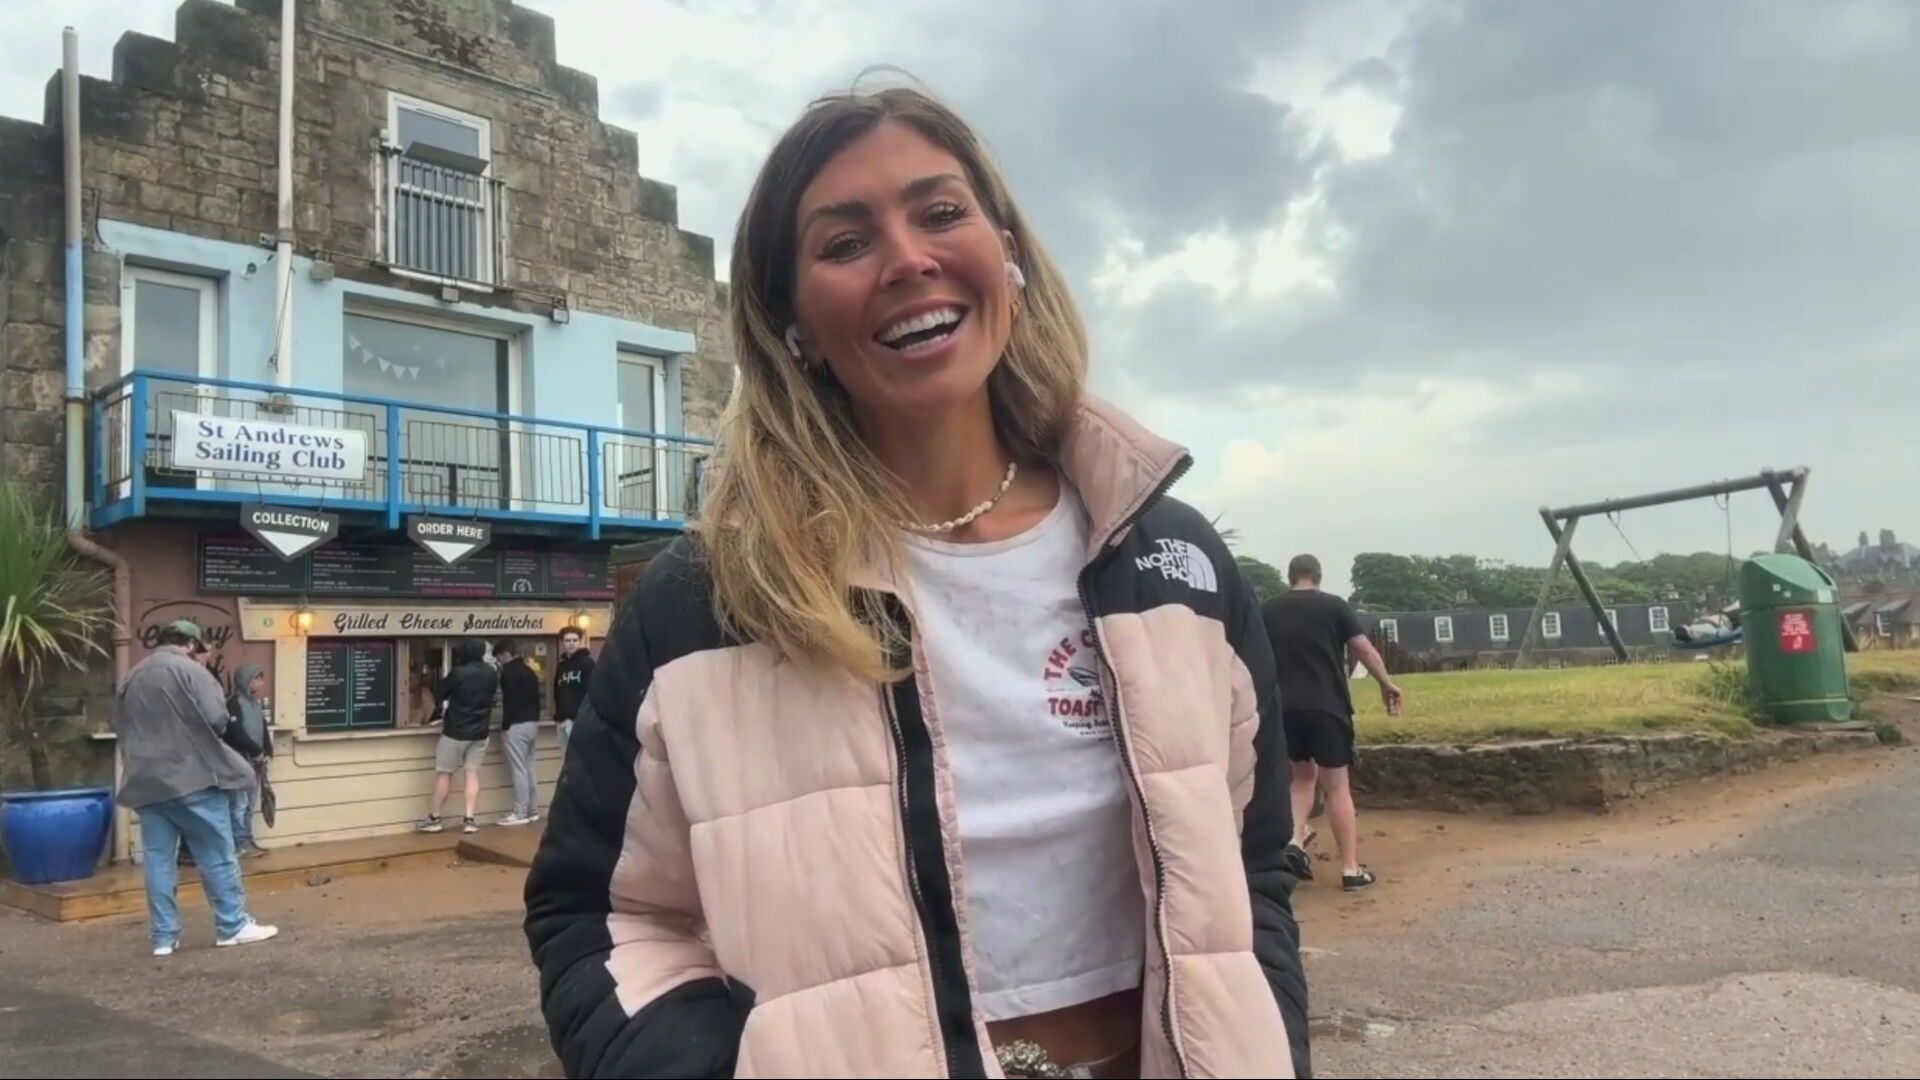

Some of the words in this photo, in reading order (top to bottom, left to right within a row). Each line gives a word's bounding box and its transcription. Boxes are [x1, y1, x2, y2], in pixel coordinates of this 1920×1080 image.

[198, 420, 224, 439] St
[234, 425, 344, 450] Andrews
[196, 441, 281, 470] Sailing
[292, 450, 346, 470] Club
[252, 511, 329, 533] COLLECTION
[417, 522, 453, 535] ORDER
[456, 525, 484, 539] HERE
[1155, 538, 1187, 553] THE
[334, 612, 389, 633] Grilled
[400, 613, 453, 629] Cheese
[463, 613, 543, 632] Sandwiches
[1044, 637, 1077, 681] THE
